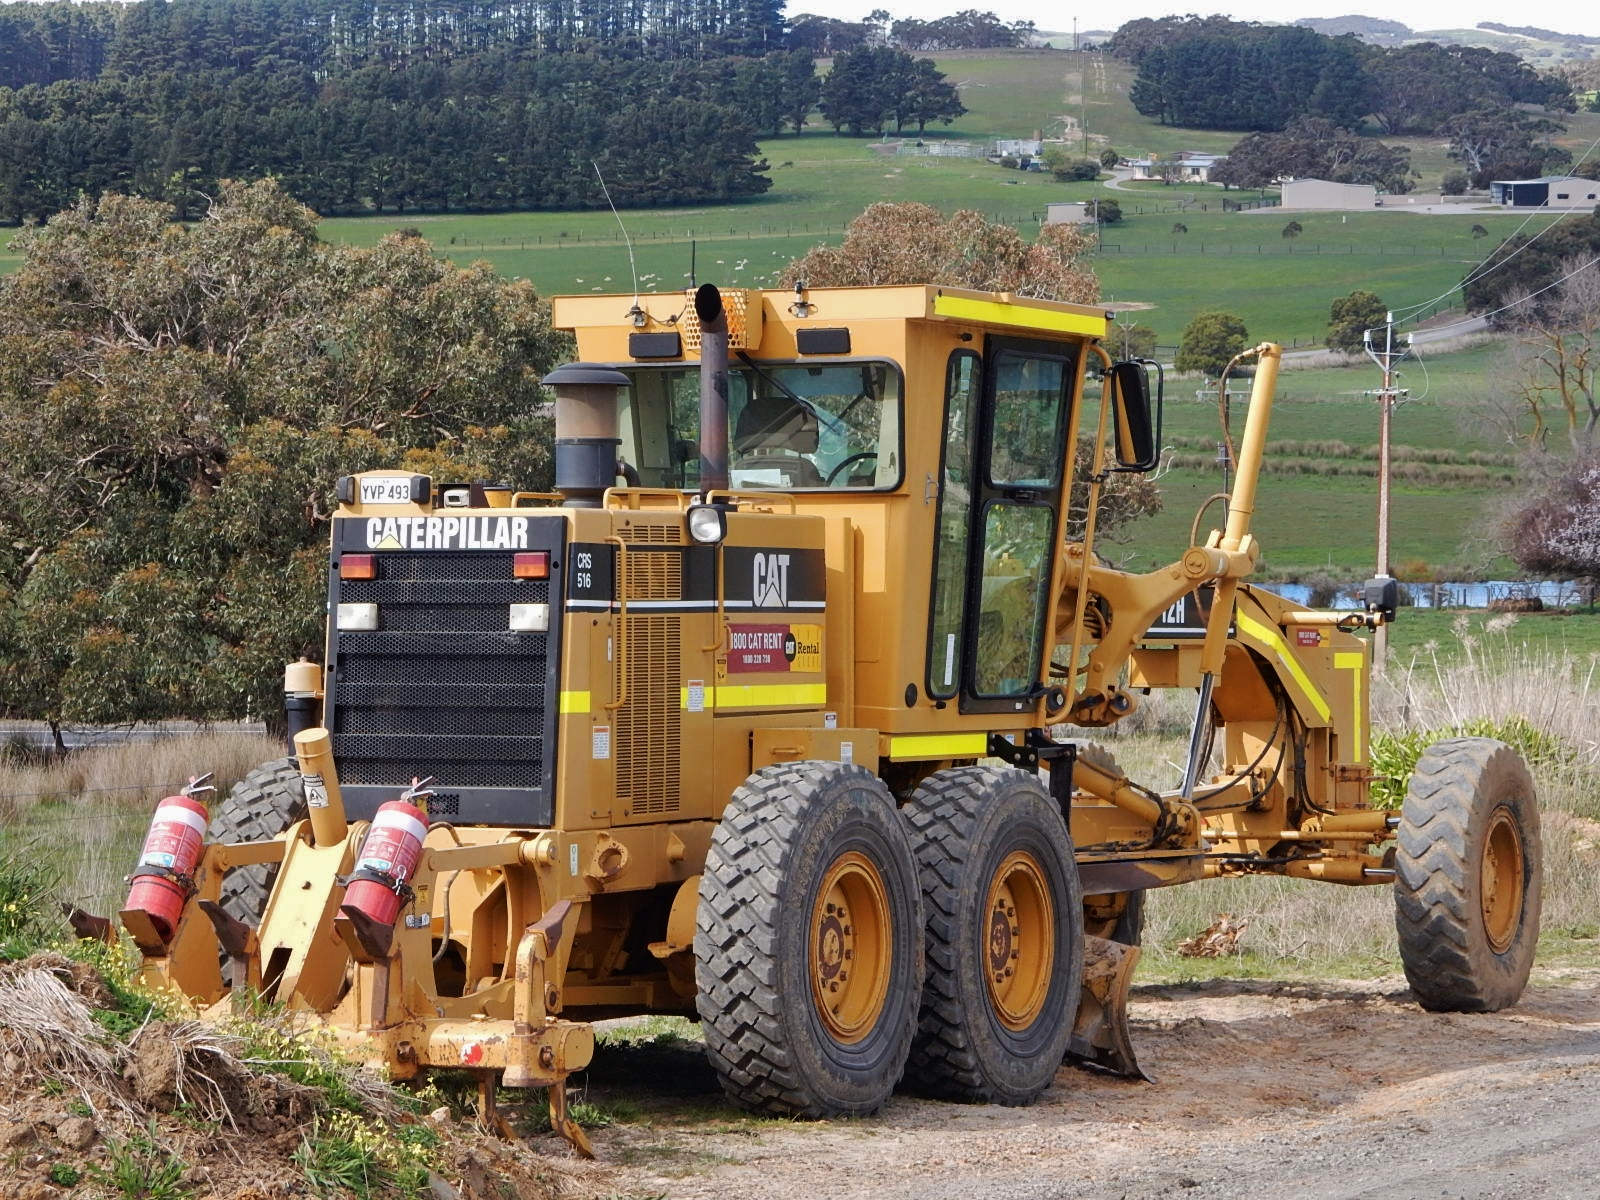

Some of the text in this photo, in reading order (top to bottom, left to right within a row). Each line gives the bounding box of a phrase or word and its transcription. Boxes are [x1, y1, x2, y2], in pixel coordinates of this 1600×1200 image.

[362, 485, 409, 500] YVP 493
[366, 516, 528, 549] CATERPILLAR
[577, 552, 592, 569] CRS
[577, 572, 592, 588] 516
[753, 552, 790, 608] CAT
[748, 632, 763, 650] CAT
[763, 632, 783, 650] RENT
[797, 641, 820, 655] Rental
